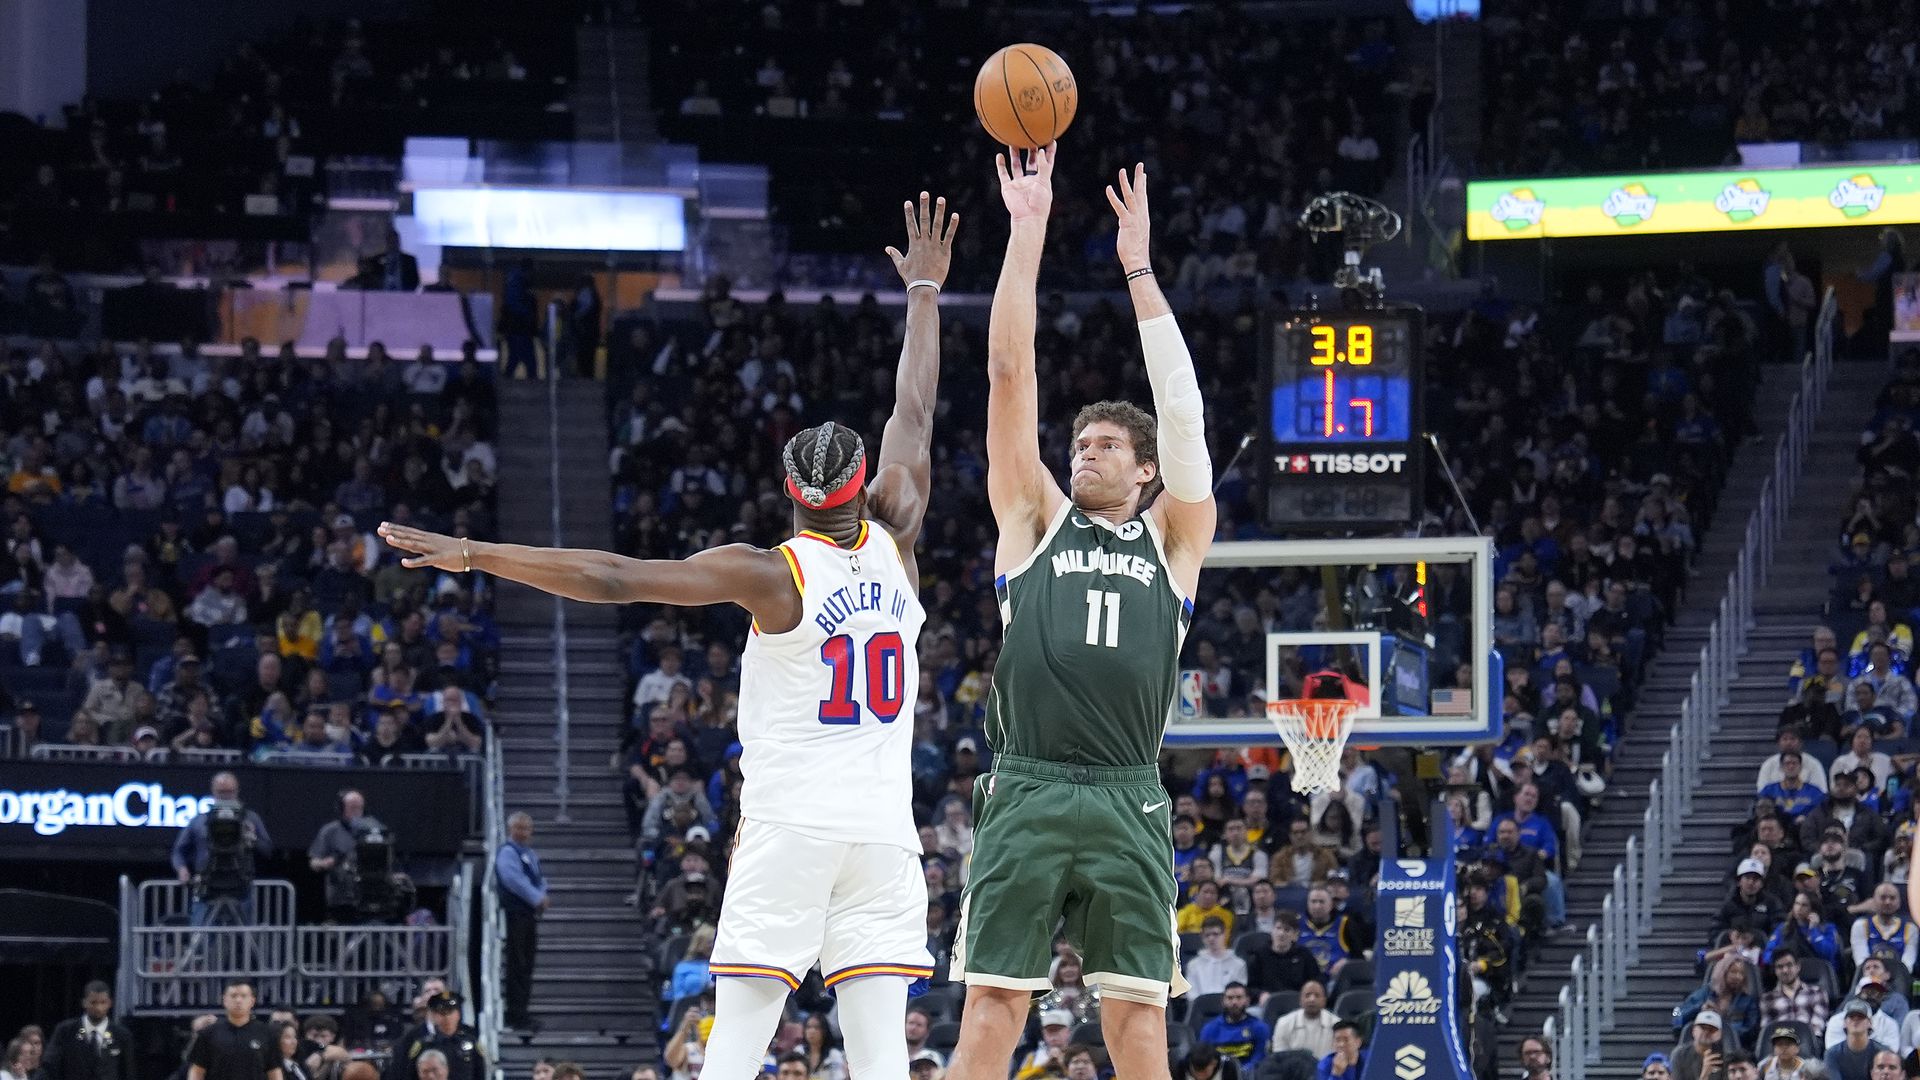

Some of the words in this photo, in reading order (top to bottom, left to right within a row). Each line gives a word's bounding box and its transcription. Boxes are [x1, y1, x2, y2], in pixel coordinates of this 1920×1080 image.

[1310, 325, 1372, 365] 3.8
[1324, 367, 1373, 437] 1.7
[1310, 454, 1407, 473] TISSOT
[1051, 546, 1157, 587] MILWUKEE
[815, 582, 881, 636] BUTLER
[891, 589, 906, 622] III
[1085, 589, 1121, 648] 11
[818, 631, 904, 725] 10
[1377, 881, 1445, 891] DOORDASH
[1383, 928, 1435, 941] CACHE
[1376, 995, 1442, 1018] Sports
[1381, 1016, 1404, 1025] BAY
[1407, 1016, 1436, 1025] AREA
